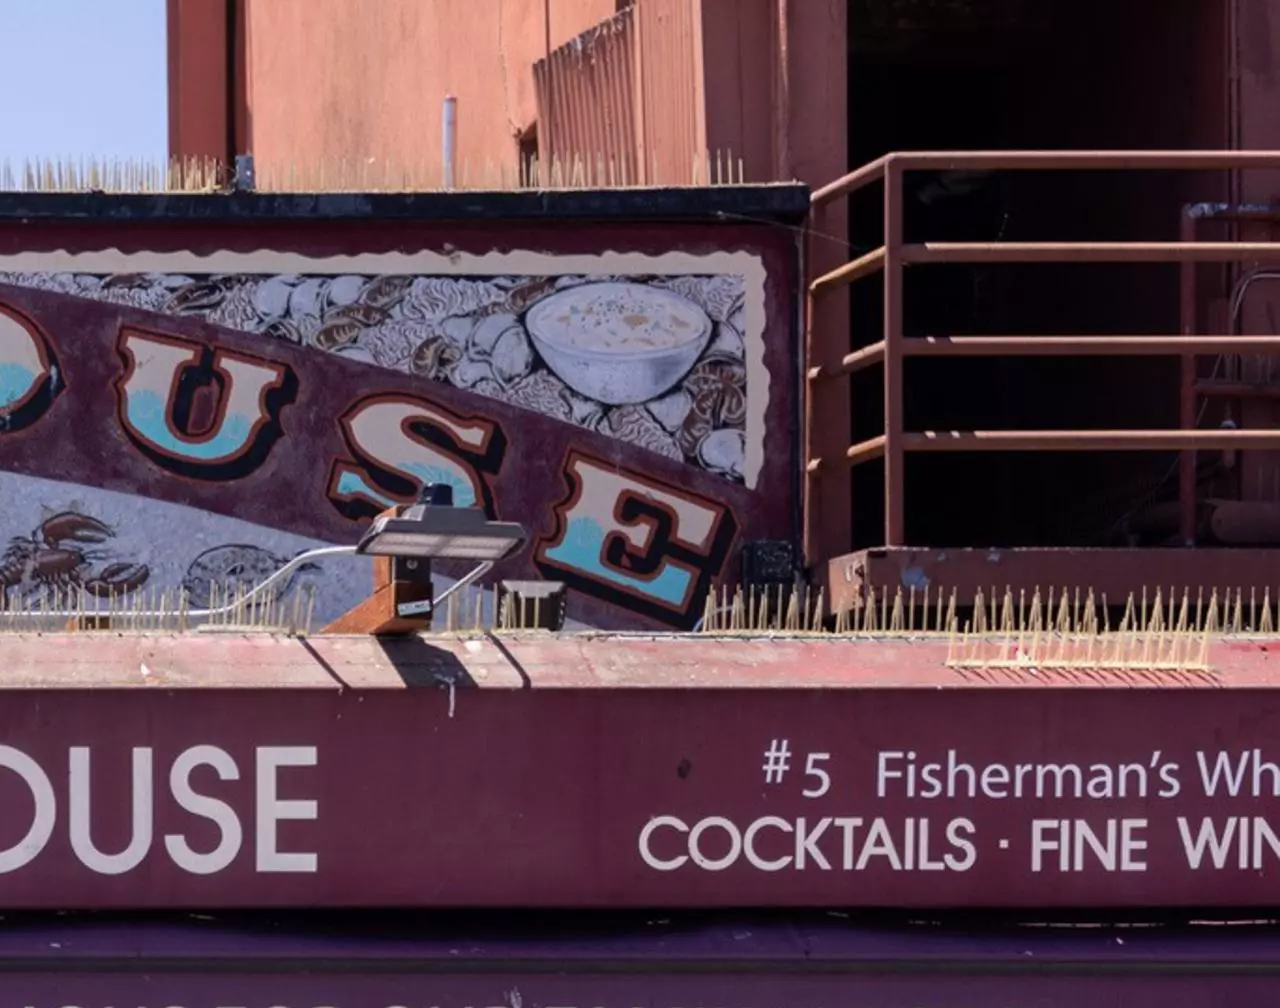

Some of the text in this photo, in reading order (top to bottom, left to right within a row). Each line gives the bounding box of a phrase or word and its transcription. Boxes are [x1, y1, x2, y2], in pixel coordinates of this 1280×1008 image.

[877, 750, 1181, 798] Fisherman's
[1196, 750, 1280, 798] Wh
[638, 815, 1280, 872] COCKTAILS FINE WIN
